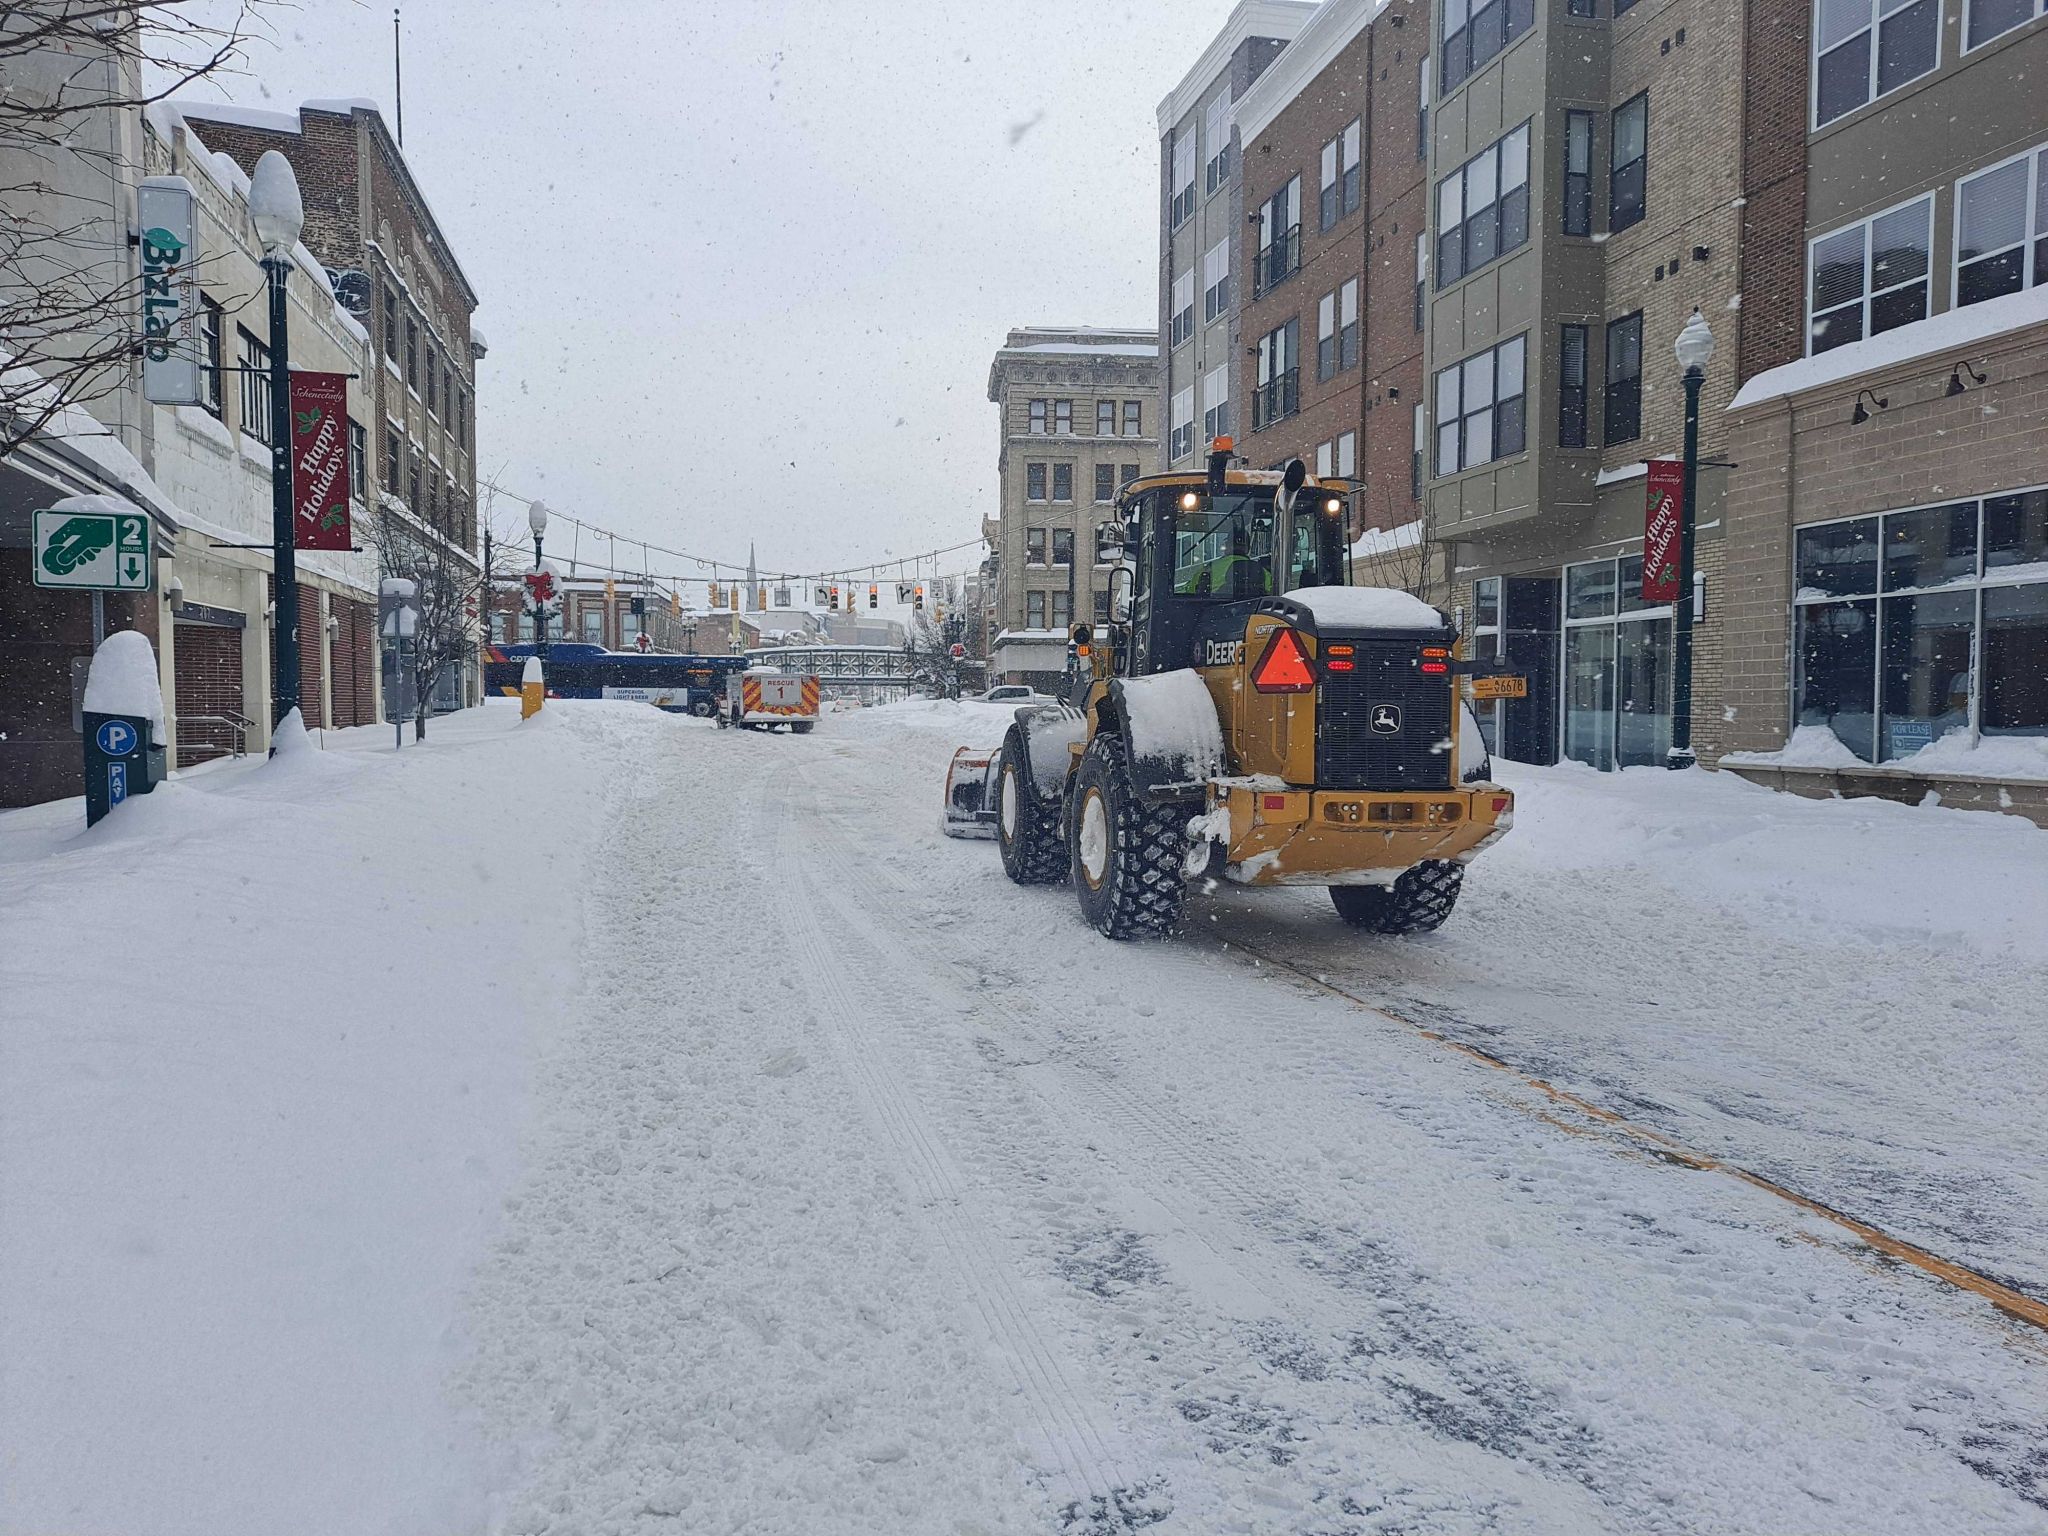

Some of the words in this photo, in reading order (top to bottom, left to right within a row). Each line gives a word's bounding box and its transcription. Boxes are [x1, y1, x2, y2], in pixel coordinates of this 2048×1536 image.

[300, 414, 338, 475] Happy
[300, 444, 345, 523] Holidays
[122, 518, 142, 545] 2
[1647, 494, 1674, 542] Happy
[1645, 518, 1678, 580] Holidays
[509, 655, 530, 663] CDT
[777, 687, 784, 699] 1
[109, 726, 127, 750] P
[1892, 724, 1907, 734] FOR
[1908, 725, 1930, 735] LEASE
[111, 765, 123, 798] PAY
